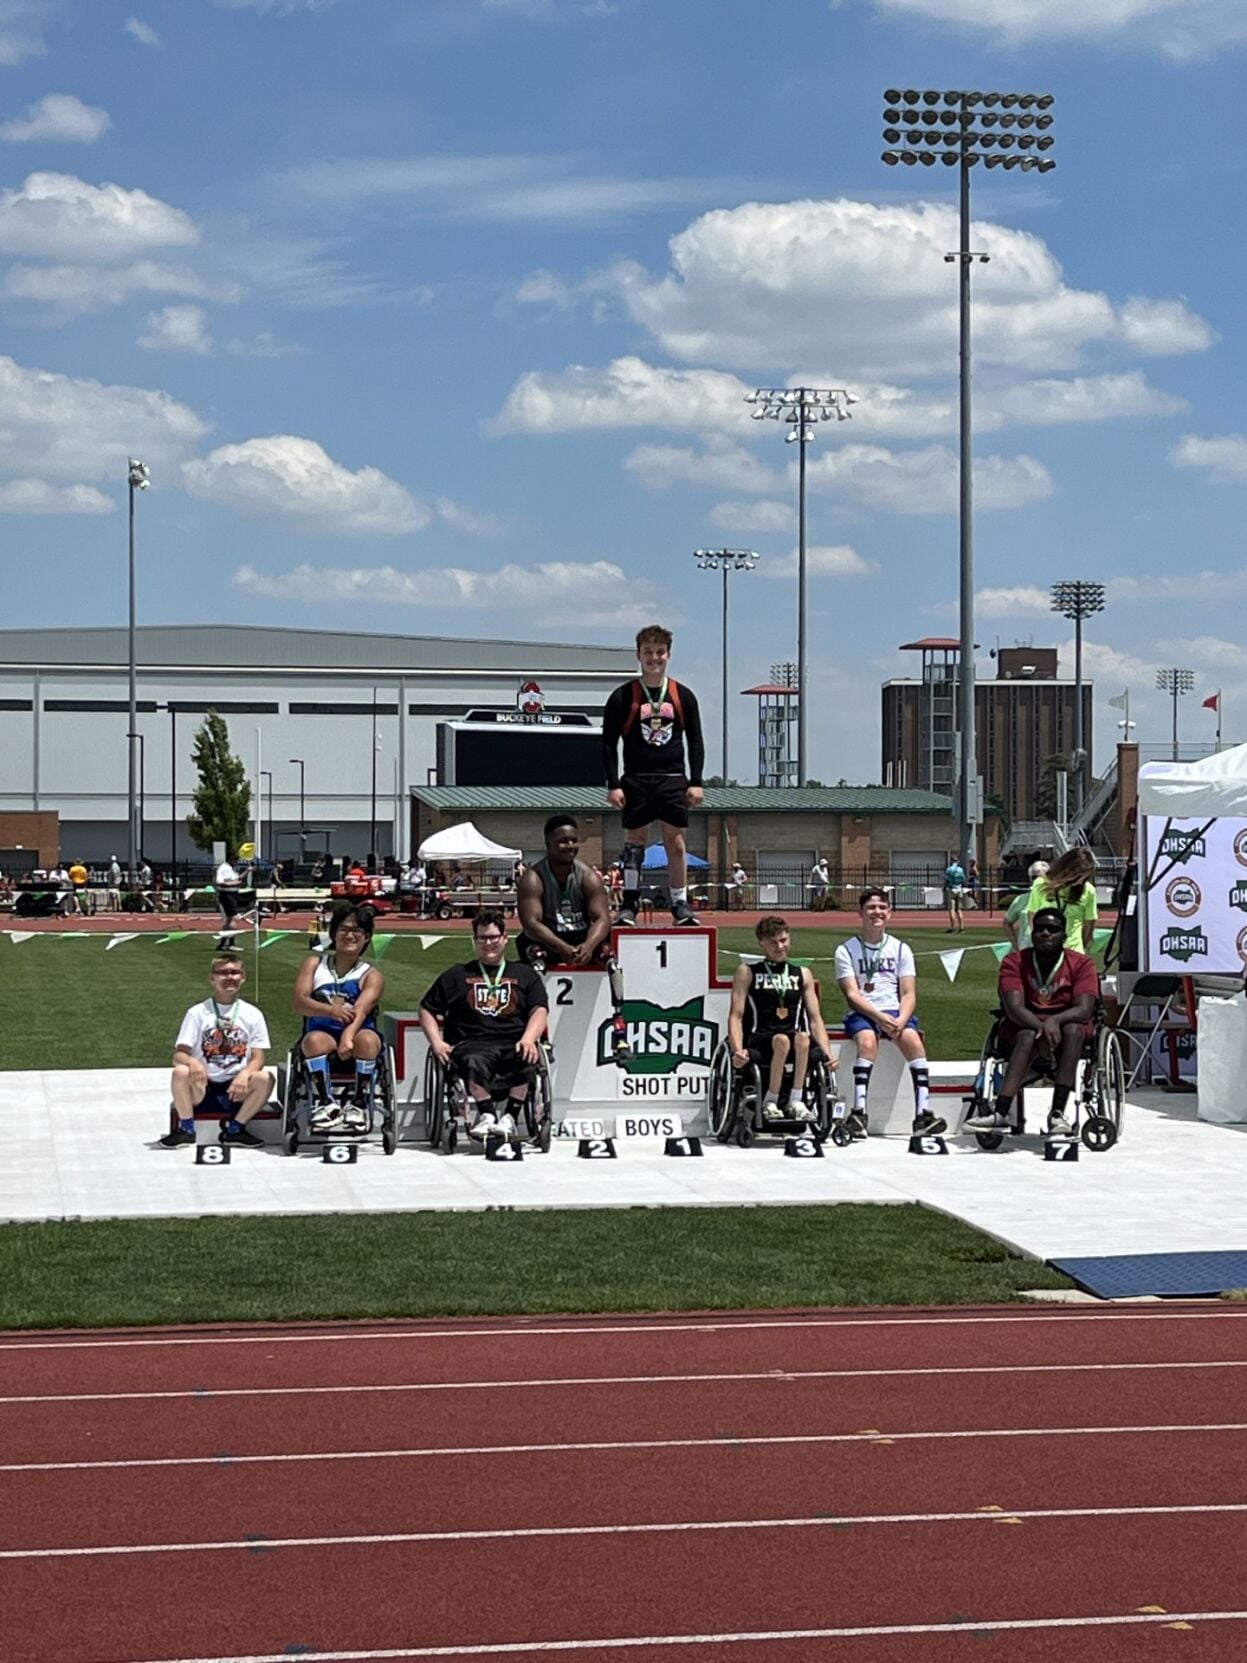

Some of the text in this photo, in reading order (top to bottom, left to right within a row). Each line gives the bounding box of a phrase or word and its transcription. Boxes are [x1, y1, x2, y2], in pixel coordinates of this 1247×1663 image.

[496, 713, 562, 724] BUCKEYE FIELD
[1162, 935, 1205, 951] OHSAA
[656, 940, 668, 968] 1
[477, 988, 508, 1004] STTE
[556, 978, 574, 1006] 2
[622, 1076, 711, 1096] SHOT PUT
[625, 1118, 674, 1137] BOYS
[329, 1145, 350, 1163] 6
[495, 1142, 517, 1160] 4
[588, 1140, 611, 1158] 2
[675, 1138, 692, 1156] 1
[795, 1139, 817, 1157] 3
[920, 1136, 941, 1154] 5
[1051, 1143, 1071, 1160] 7
[201, 1145, 224, 1164] 8
